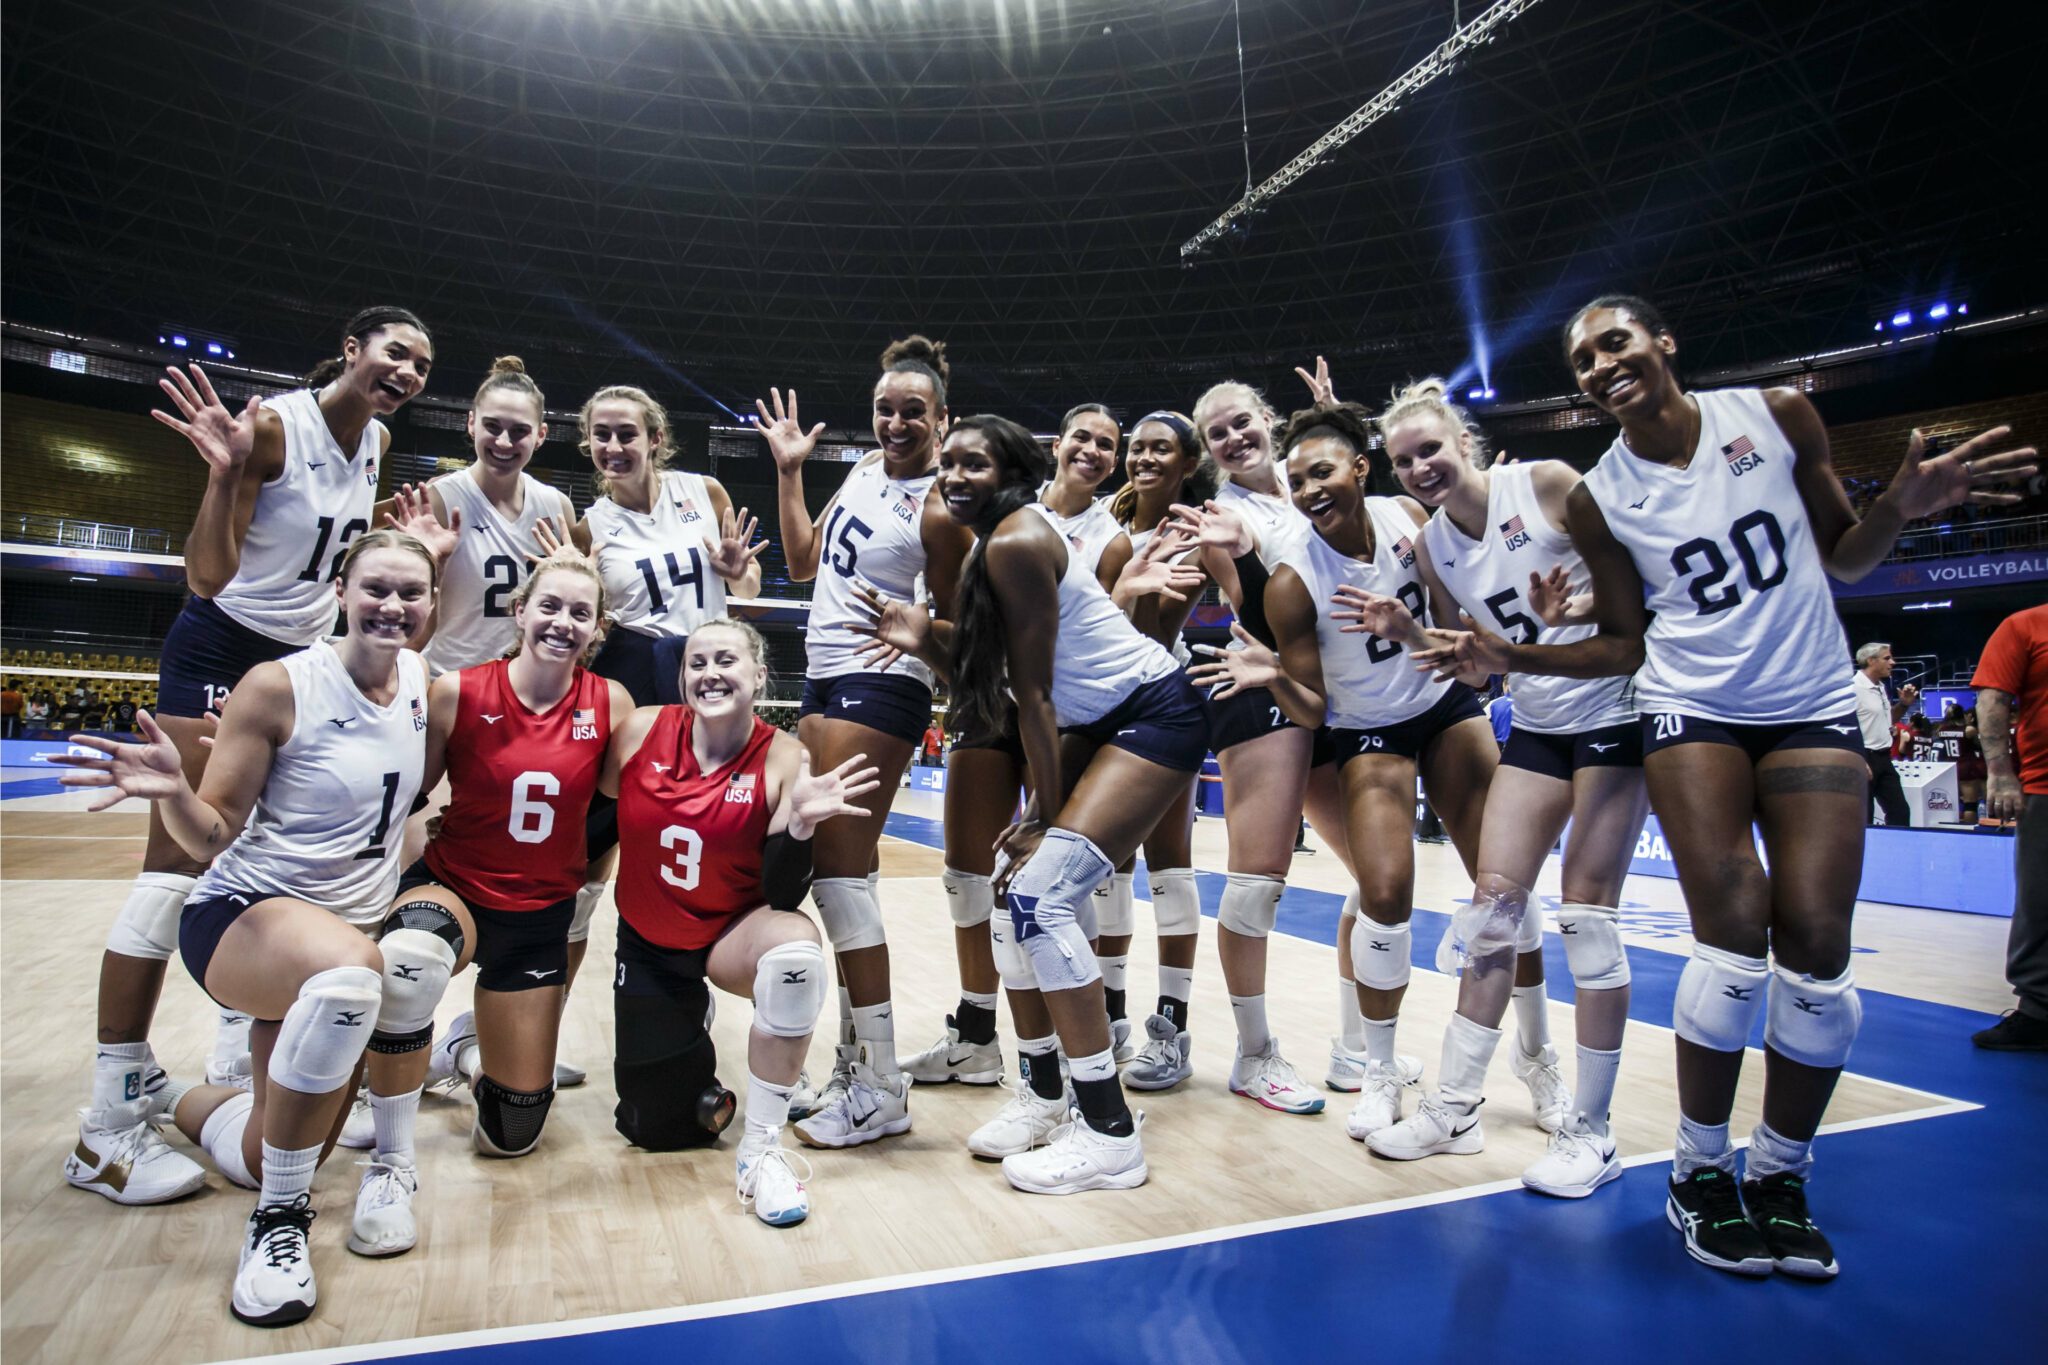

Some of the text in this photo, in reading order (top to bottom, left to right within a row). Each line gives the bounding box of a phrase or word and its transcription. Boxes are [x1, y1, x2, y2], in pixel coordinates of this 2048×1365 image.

[1728, 456, 1765, 477] USA
[680, 511, 701, 523] USA
[892, 502, 912, 524] USA
[822, 505, 873, 579] 15
[1505, 531, 1531, 551] USA
[1670, 509, 1788, 616] 20
[635, 547, 704, 616] 14
[1484, 587, 1538, 644] 5
[1269, 706, 1290, 726] 2
[1653, 714, 1682, 740] 20
[572, 725, 597, 740] USA
[1359, 735, 1383, 751] 29
[508, 771, 560, 844] 6
[725, 788, 752, 804] USA
[353, 771, 400, 860] 1
[660, 824, 703, 891] 3
[618, 962, 626, 986] 3
